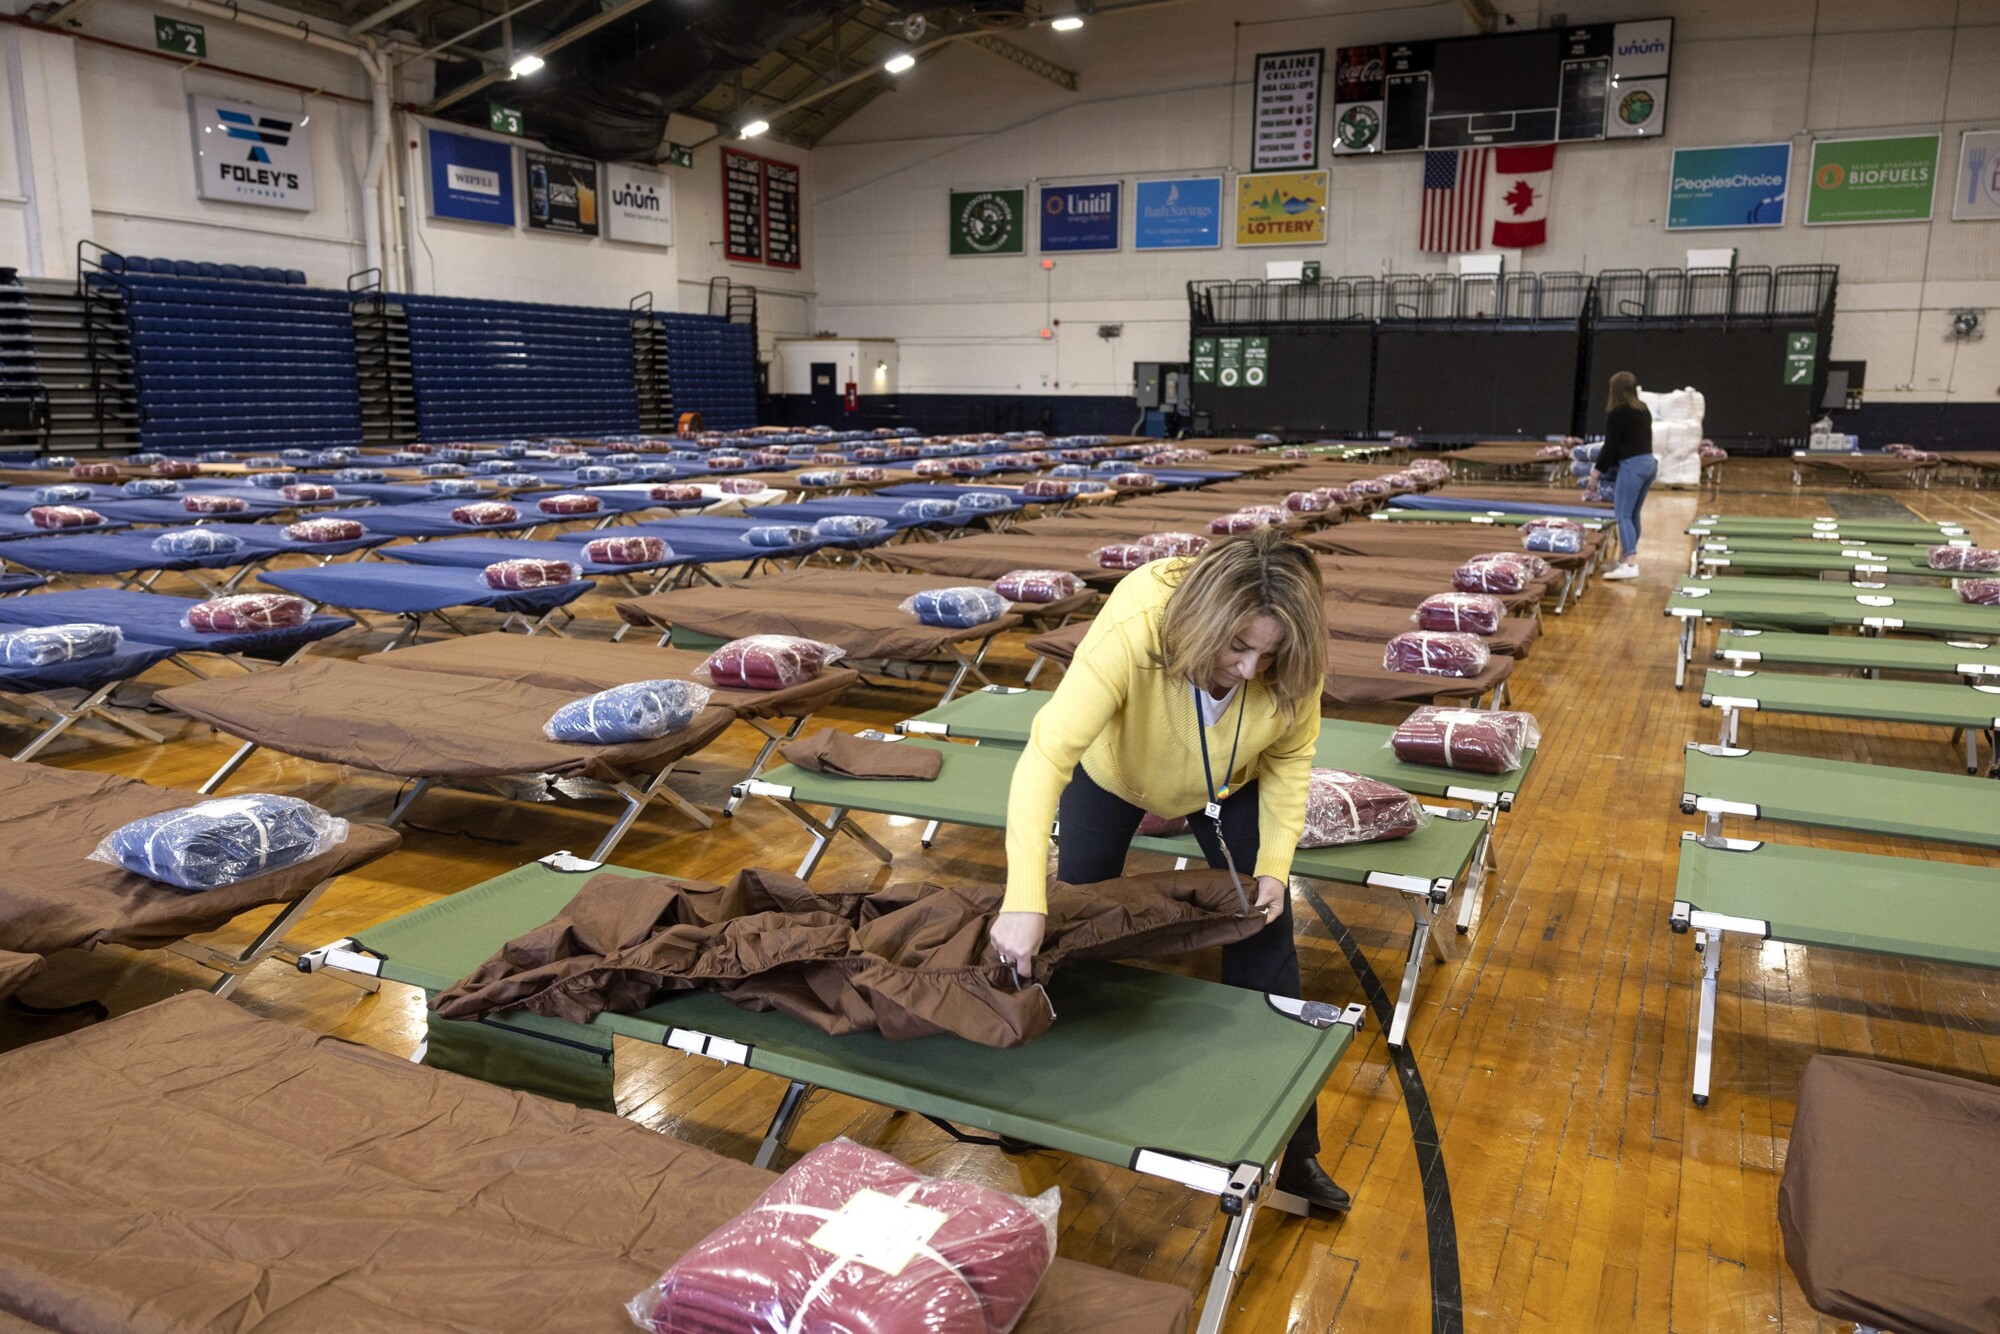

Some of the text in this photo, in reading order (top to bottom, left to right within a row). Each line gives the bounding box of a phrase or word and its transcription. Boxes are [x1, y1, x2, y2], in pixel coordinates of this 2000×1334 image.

[184, 35, 197, 53] 2
[1618, 38, 1665, 56] unum
[1263, 56, 1316, 72] MAINE
[1266, 69, 1311, 80] CELTICS
[508, 117, 518, 133] 3
[682, 153, 690, 167] 4
[219, 163, 299, 190] FOLEY'S
[455, 172, 492, 188] WIPFLI
[1673, 173, 1783, 192] PeoplesChoice
[1848, 168, 1929, 185] BIOFUELS
[236, 187, 286, 199] FITNESS
[612, 182, 660, 212] unum
[1067, 192, 1112, 215] Unitil
[1144, 205, 1212, 218] Bath Savings
[1247, 220, 1314, 235] LOTTERY
[1305, 268, 1314, 278] 5
